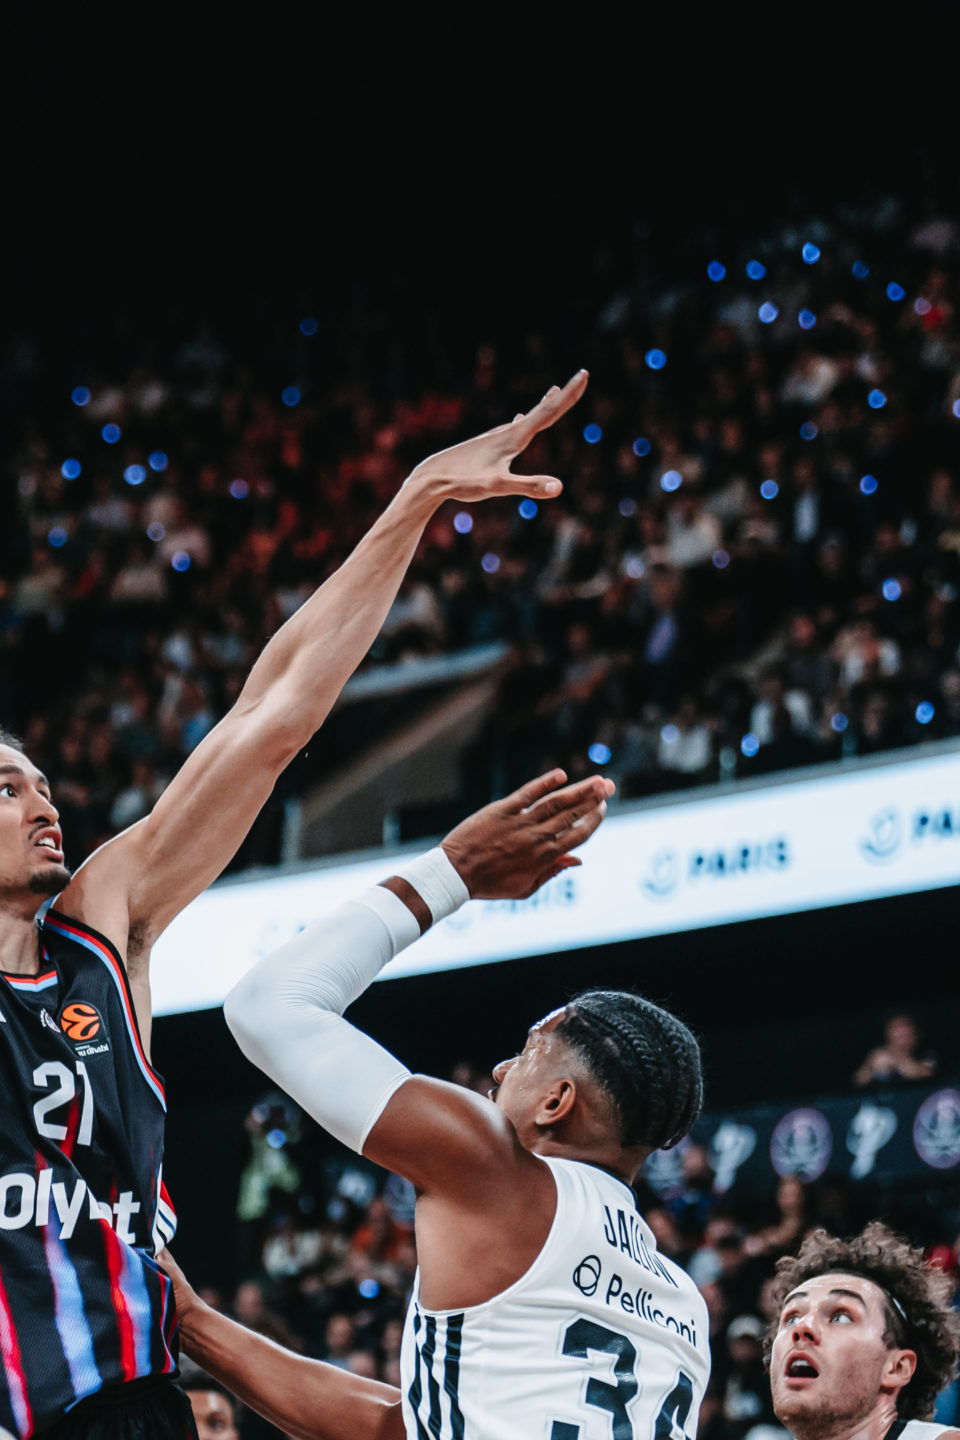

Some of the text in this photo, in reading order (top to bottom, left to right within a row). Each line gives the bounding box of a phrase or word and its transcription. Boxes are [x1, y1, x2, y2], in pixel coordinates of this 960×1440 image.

[688, 836, 788, 883] PARIS
[32, 1060, 93, 1146] 21
[606, 1273, 696, 1348] Pelliconi
